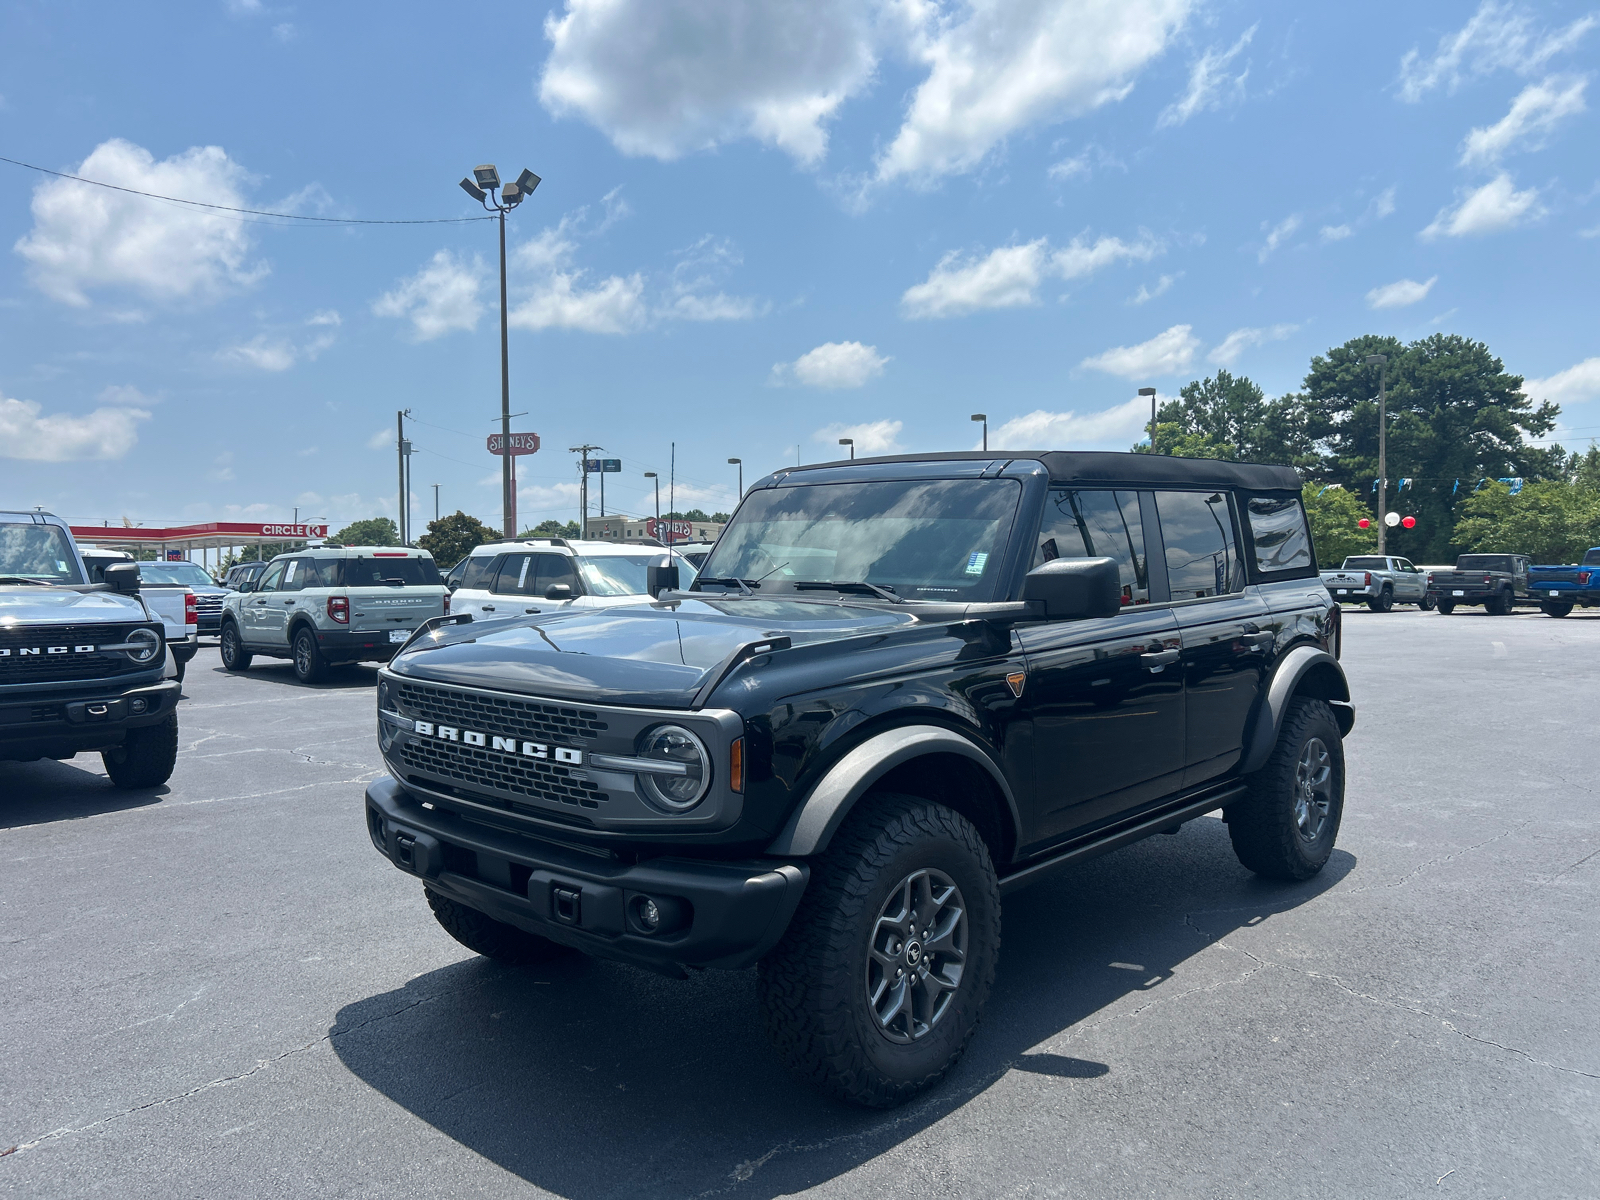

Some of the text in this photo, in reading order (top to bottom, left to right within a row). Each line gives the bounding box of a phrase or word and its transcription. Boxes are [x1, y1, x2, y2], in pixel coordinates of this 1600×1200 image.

[490, 435, 535, 450] SHNEY'S
[262, 525, 320, 537] CIRCLE K
[415, 720, 583, 765] BRONCO
